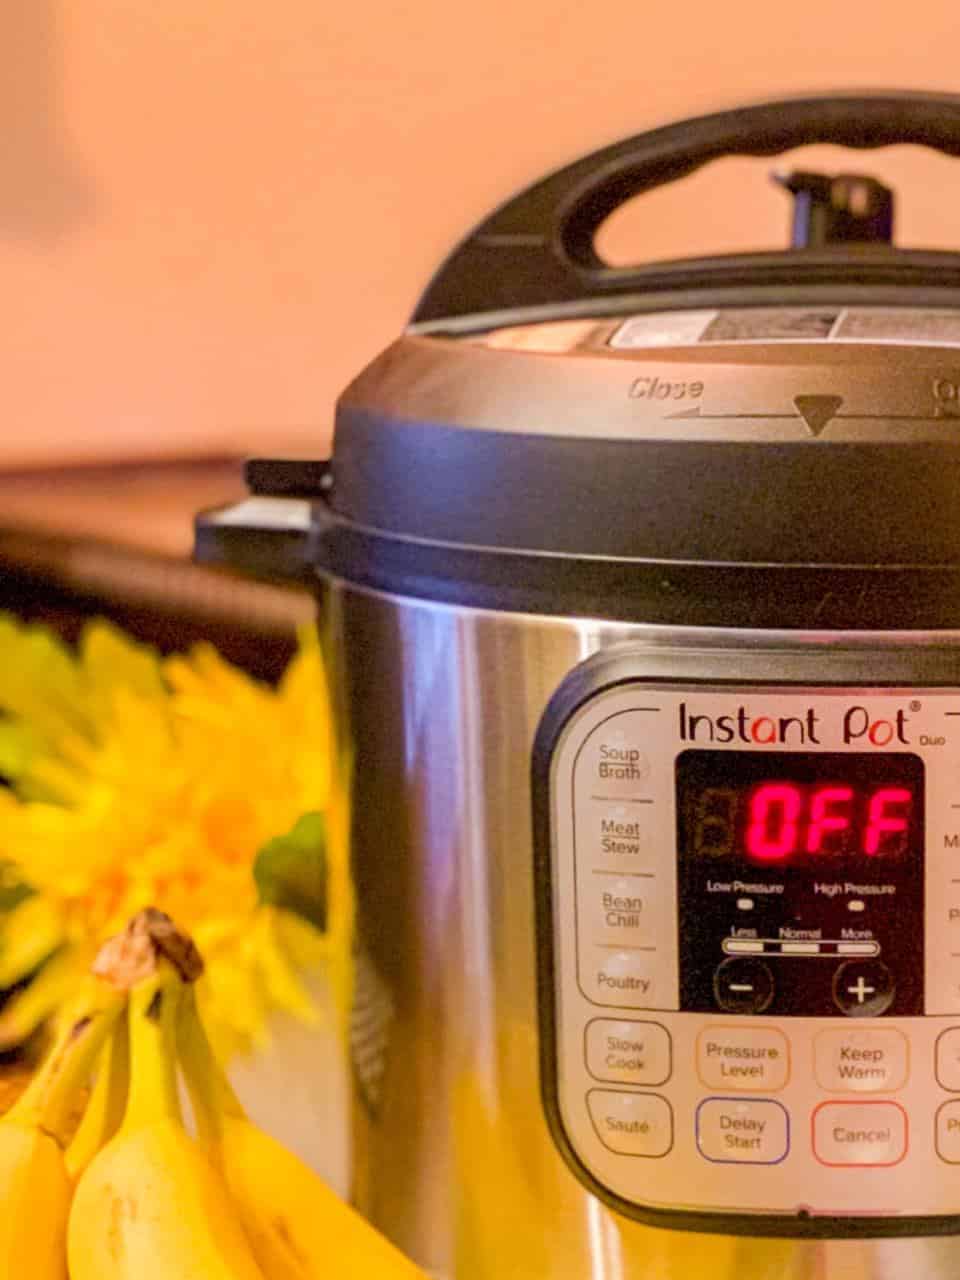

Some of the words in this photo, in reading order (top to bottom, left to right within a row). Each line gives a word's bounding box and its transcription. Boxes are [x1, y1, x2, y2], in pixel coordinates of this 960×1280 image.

[628, 376, 704, 400] Close
[679, 703, 820, 744] Instant
[919, 735, 946, 746] Duo
[600, 745, 639, 763] Soup
[599, 763, 641, 780] Broth
[601, 819, 640, 835] Meat
[747, 783, 912, 858] OFF
[601, 838, 640, 855] Stew
[707, 880, 731, 892] Low
[734, 881, 784, 894] Pressure
[814, 882, 842, 898] High
[845, 882, 896, 895] Pressure
[602, 892, 642, 910] Bean
[605, 912, 641, 928] Chili
[779, 927, 822, 939] Normal
[597, 973, 650, 992] Poultry
[606, 1036, 644, 1053] Slow
[706, 1042, 778, 1061] Pressure
[605, 1054, 645, 1071] Cook
[840, 1046, 884, 1064] Keep
[720, 1061, 764, 1078] Level
[837, 1062, 886, 1080] Warm
[720, 1115, 766, 1134] Delay
[724, 1133, 762, 1150] Start
[832, 1127, 891, 1144] Cancel
